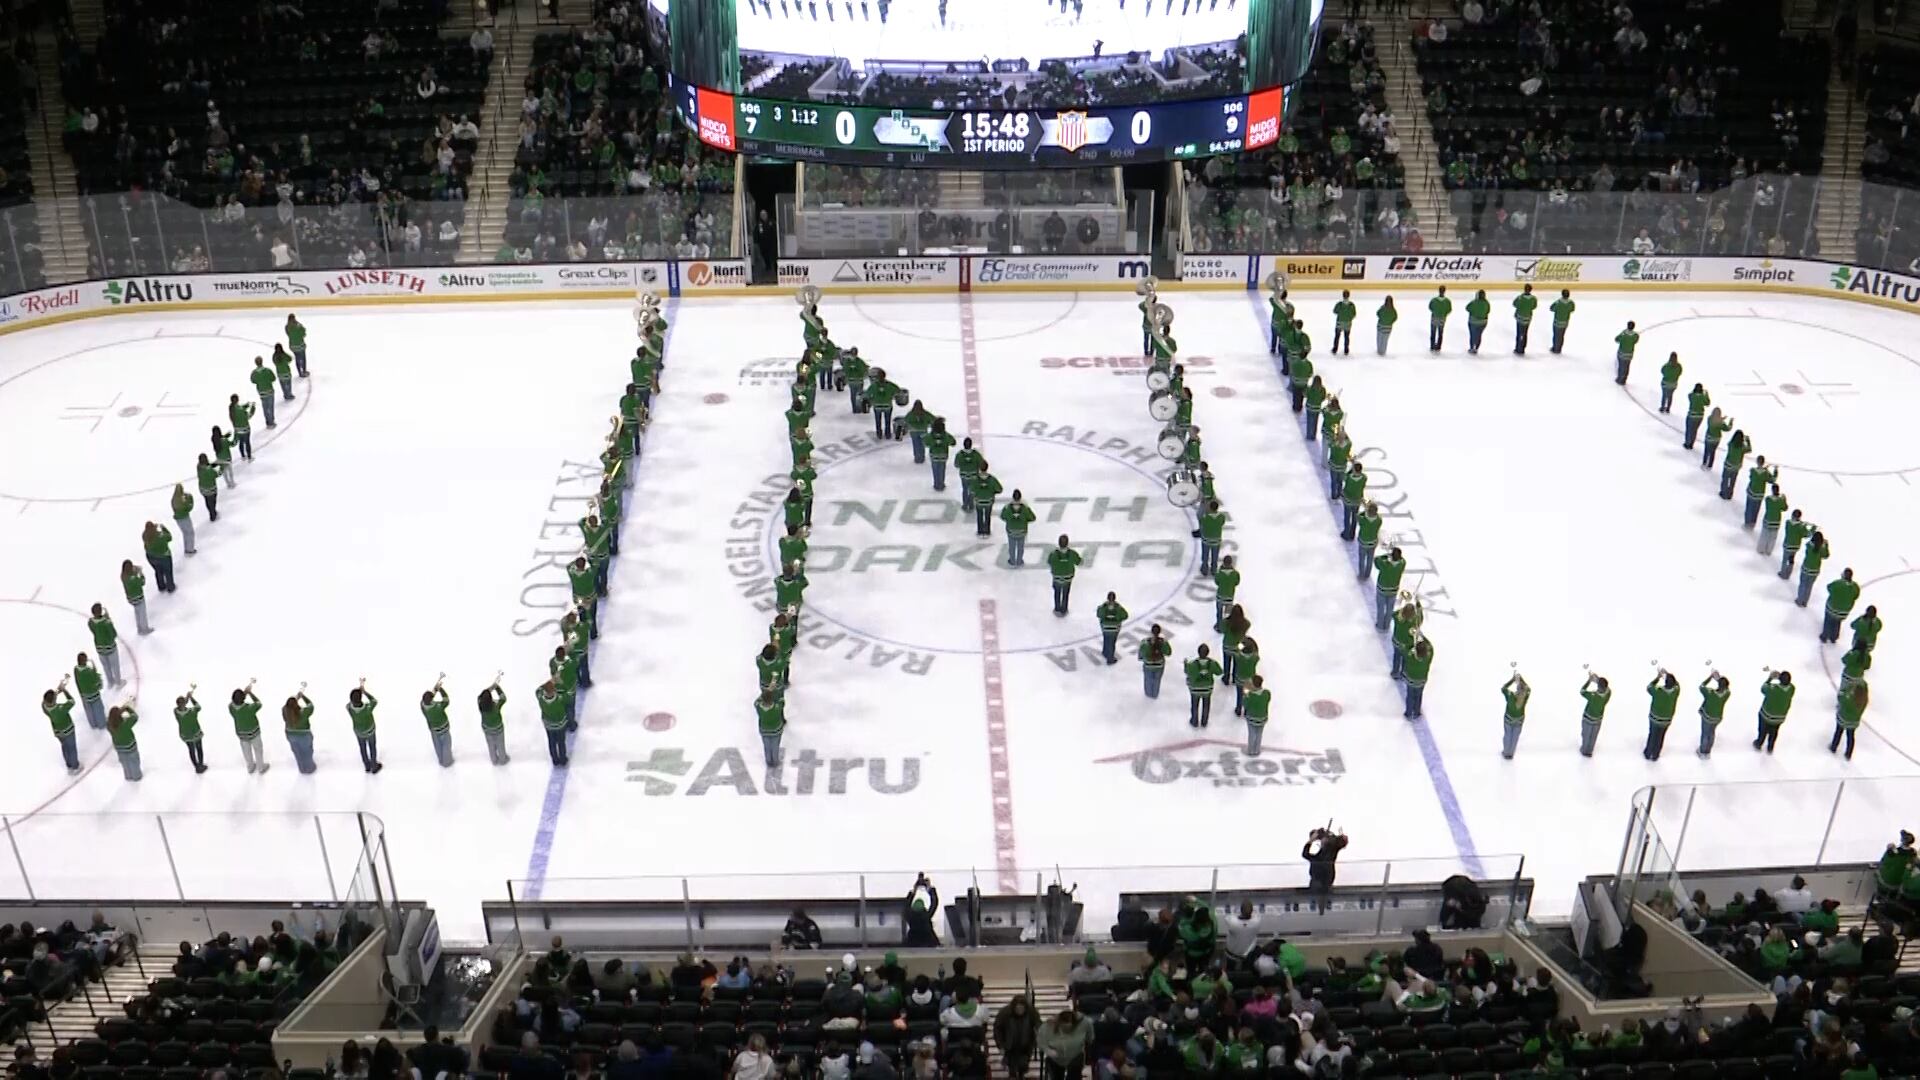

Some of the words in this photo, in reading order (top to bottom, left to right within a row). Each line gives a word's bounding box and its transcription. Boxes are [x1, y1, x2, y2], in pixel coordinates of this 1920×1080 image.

[740, 103, 761, 113] SOG
[774, 107, 782, 122] 3
[791, 108, 818, 124] 1:12
[1223, 102, 1243, 114] SOG
[700, 117, 727, 134] MIDCO
[745, 117, 757, 133] 7
[835, 111, 856, 144] 0
[961, 113, 1030, 138] 15:48
[1131, 111, 1151, 144] 0
[1226, 116, 1239, 134] 9
[1249, 117, 1276, 134] MIDCO
[701, 128, 731, 146] SPORTS
[1248, 127, 1278, 146] SPORTS
[775, 144, 825, 157] MERRIMACK
[964, 139, 982, 152] 1ST
[985, 140, 1025, 152] PERIOD
[863, 260, 946, 273] Greenberg
[1006, 263, 1029, 272] First
[1033, 262, 1099, 272] Community
[1287, 263, 1335, 275] Butler
[1344, 263, 1364, 273] CAT
[1421, 258, 1483, 270] Nodak
[449, 274, 485, 287] Altru
[558, 270, 592, 281] Great
[597, 267, 628, 280] Clips
[865, 271, 913, 284] Realty
[1004, 272, 1034, 281] Credit
[1038, 271, 1068, 281] Union
[1384, 271, 1432, 279] Insurance
[1434, 271, 1480, 281] Company
[1641, 273, 1680, 281] VALLEY
[1733, 267, 1795, 283] Simplot
[324, 271, 425, 295] LUNSETH
[1848, 269, 1920, 303] Altru
[124, 279, 193, 304] Altru
[19, 290, 79, 314] Rydell
[1040, 356, 1214, 368] SCHES
[1021, 420, 1158, 465] RALPH
[799, 539, 1187, 573] DAKOTA
[685, 747, 920, 796] Altru
[1131, 749, 1346, 784] Oxford
[1213, 776, 1342, 787] REALTY
